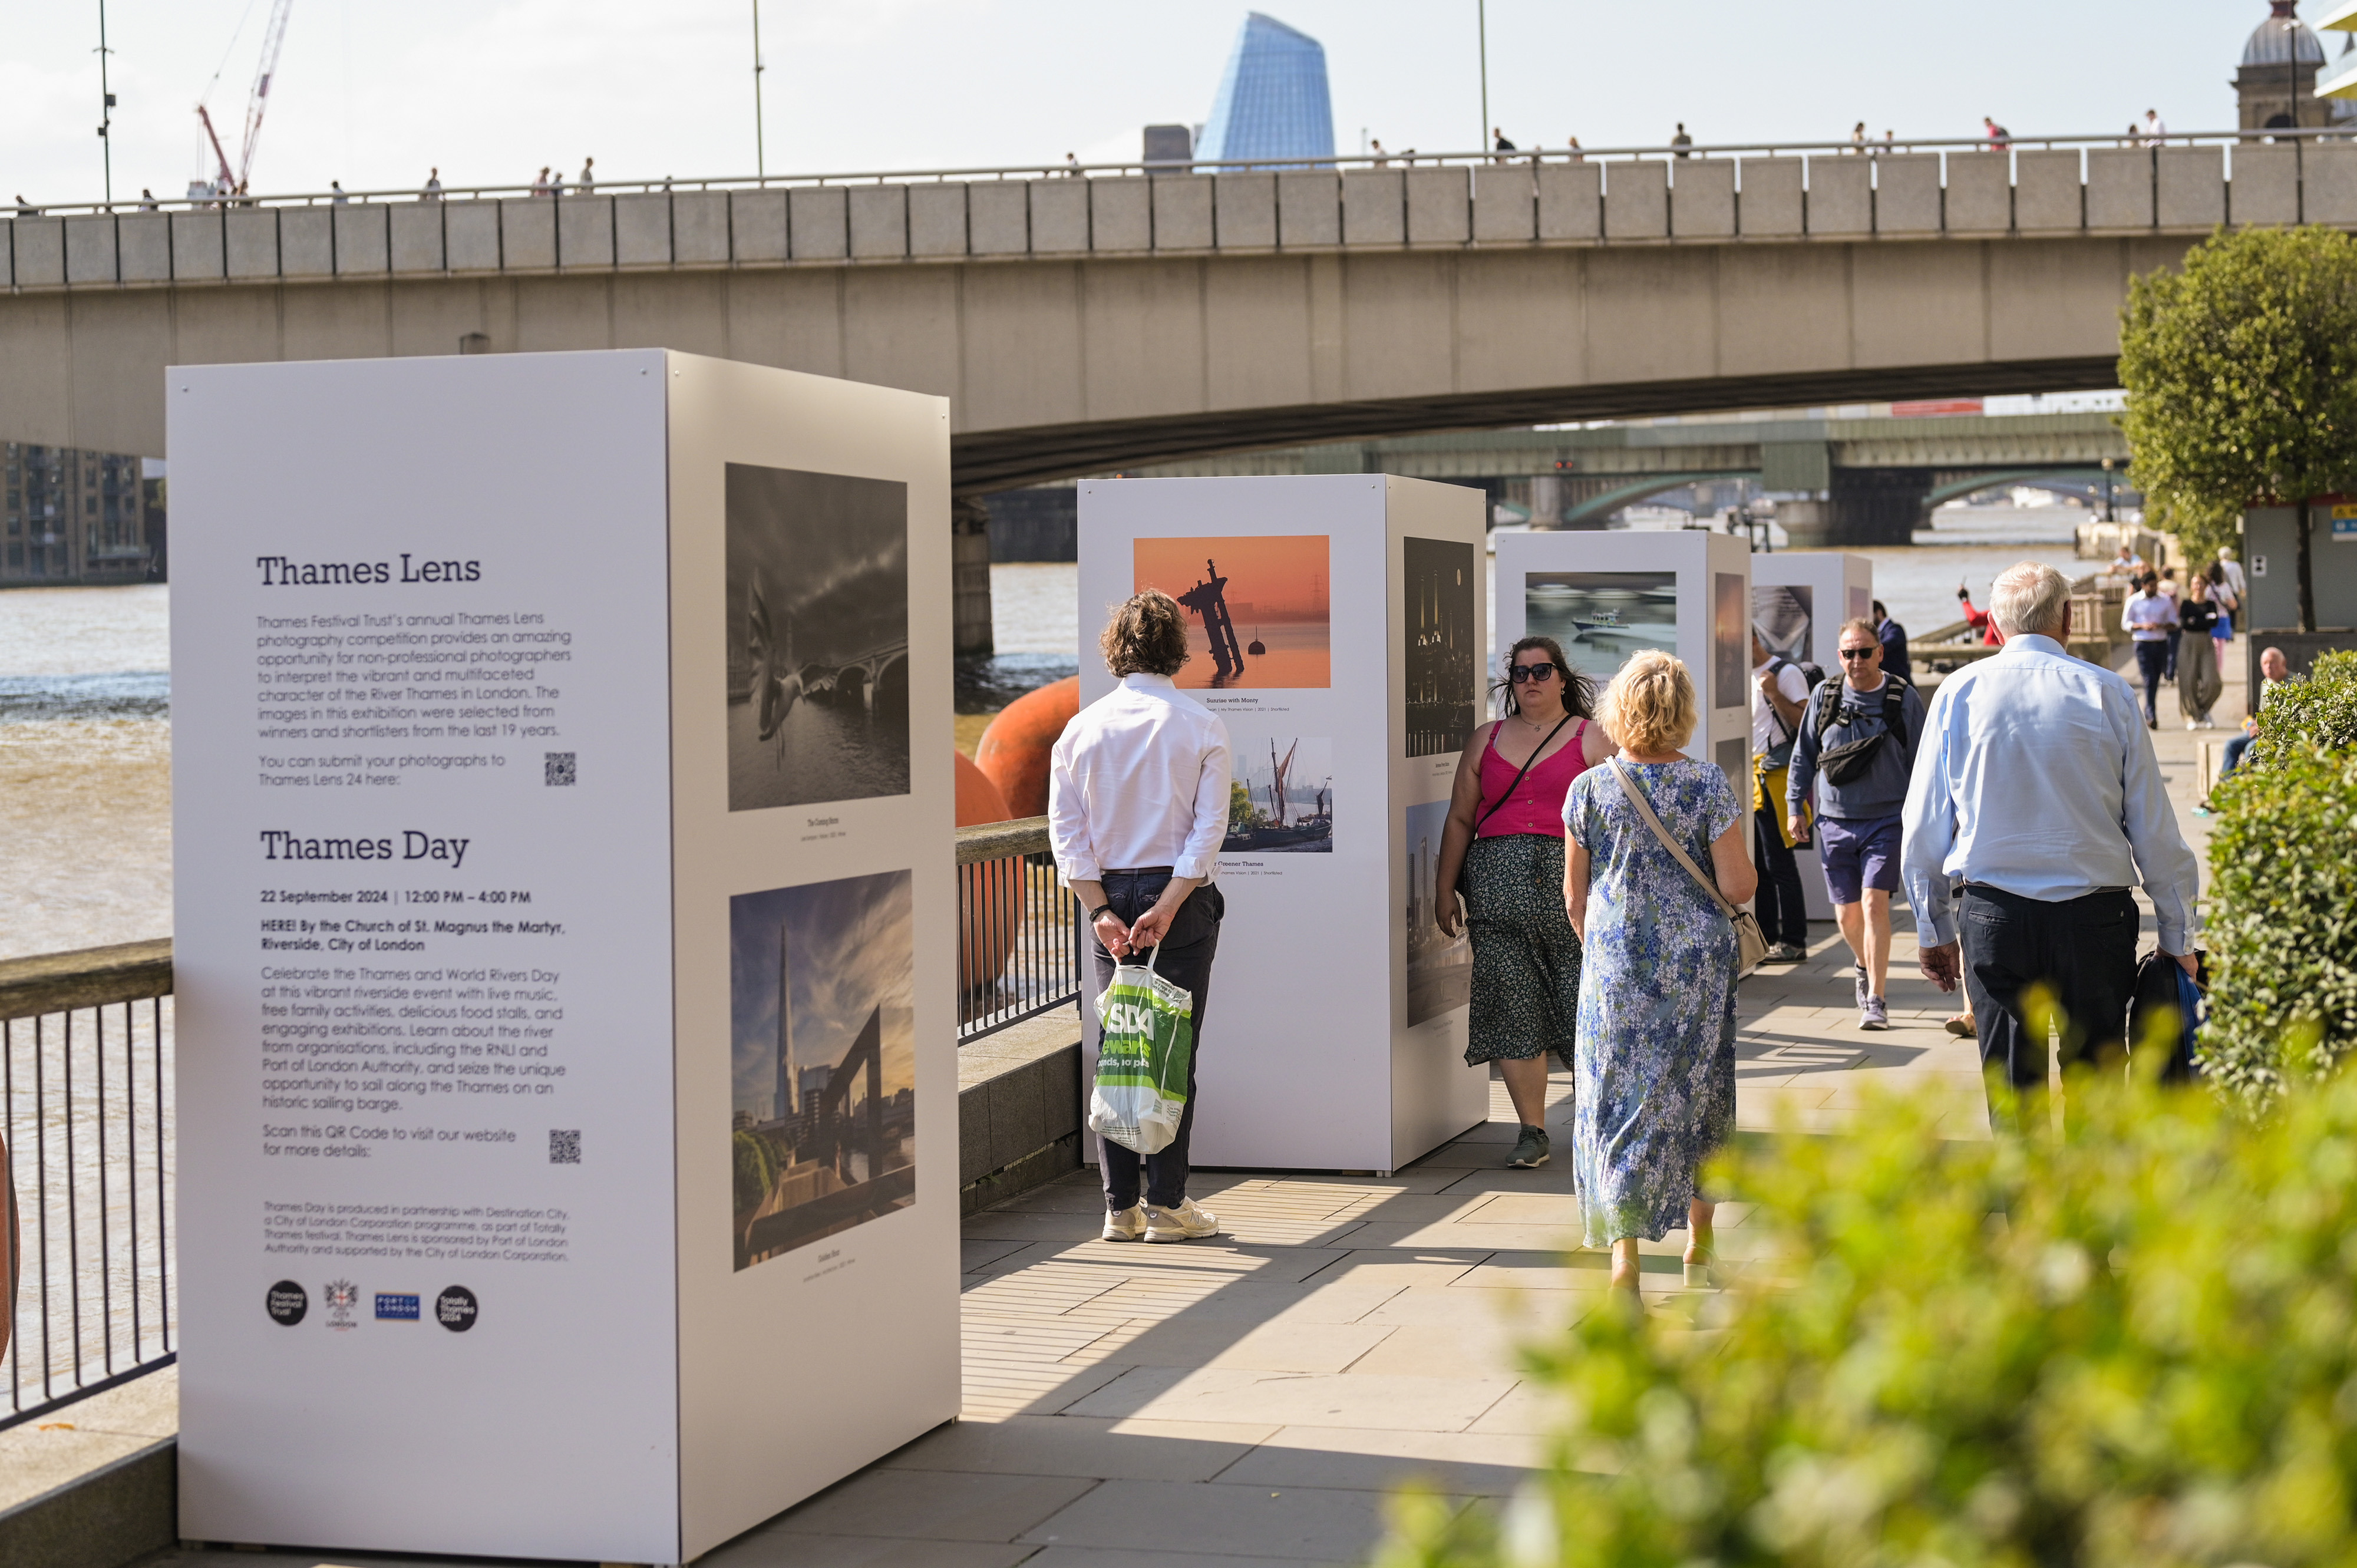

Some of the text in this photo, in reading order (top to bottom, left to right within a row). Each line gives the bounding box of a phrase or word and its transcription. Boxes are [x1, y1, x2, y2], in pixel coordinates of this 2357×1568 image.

[256, 553, 481, 586] Thames Lens
[256, 612, 544, 629] Thames Festival Trust's annual Thames Lens
[257, 630, 572, 649] photography competition provides an amazing
[257, 650, 572, 667] opportunity for non-professional photographers
[258, 669, 534, 684] to interpret the vibrant and multifaceted
[258, 691, 324, 702] character
[328, 688, 341, 701] of
[345, 689, 367, 701] the
[371, 688, 402, 701] River
[407, 688, 458, 700] Thames
[461, 690, 473, 699] in
[536, 686, 560, 699] The
[258, 727, 308, 738] winners
[311, 726, 339, 738] and
[342, 725, 409, 738] shortlisters
[412, 724, 444, 737] from
[447, 725, 470, 737] the
[474, 724, 497, 737] last
[502, 723, 517, 735] 19
[258, 754, 506, 770] You can submit your photographs to
[259, 773, 311, 787] Thames
[313, 774, 344, 786] Lens
[346, 773, 362, 786] 24
[259, 830, 471, 867] Thames Day
[260, 889, 532, 905] 22 September 2024 12:00 PM 4:00 PM
[300, 919, 316, 935] By
[319, 920, 342, 933] the
[344, 919, 395, 933] Church
[397, 919, 412, 933] of
[434, 920, 489, 936] Magnus
[491, 920, 514, 934] the
[328, 937, 355, 953] City
[358, 938, 372, 951] of
[375, 938, 425, 952] London
[261, 967, 560, 984] Celebrate the Thames and World Rivers Day
[262, 1003, 288, 1017] free
[291, 1004, 331, 1018] family
[398, 1005, 458, 1018] delicious
[461, 1006, 493, 1019] food
[534, 1007, 563, 1020] and
[262, 1024, 328, 1038] engaging
[410, 1025, 448, 1036] Learn
[451, 1025, 494, 1038] about
[498, 1025, 521, 1038] the
[524, 1025, 554, 1039] river
[262, 1058, 288, 1071] Port
[291, 1059, 304, 1072] of
[308, 1061, 358, 1072] London
[427, 1063, 455, 1074] and
[458, 1064, 490, 1075] seize
[494, 1063, 516, 1076] the
[519, 1063, 566, 1078] unique
[263, 1095, 308, 1108] historic
[312, 1096, 354, 1113] sailing
[263, 1124, 517, 1143] Scan this QR Code to visit our website
[263, 1142, 281, 1156] for
[285, 1145, 320, 1157] more
[264, 1243, 309, 1255] Authority
[312, 1246, 333, 1255] and
[335, 1247, 388, 1256] supported
[389, 1247, 403, 1257] by
[405, 1247, 423, 1257] the
[425, 1247, 445, 1259] City
[448, 1248, 458, 1258] of
[461, 1250, 500, 1260] London
[377, 1304, 417, 1312] LONDON
[440, 1296, 468, 1306] Totally
[440, 1305, 475, 1314] Thames
